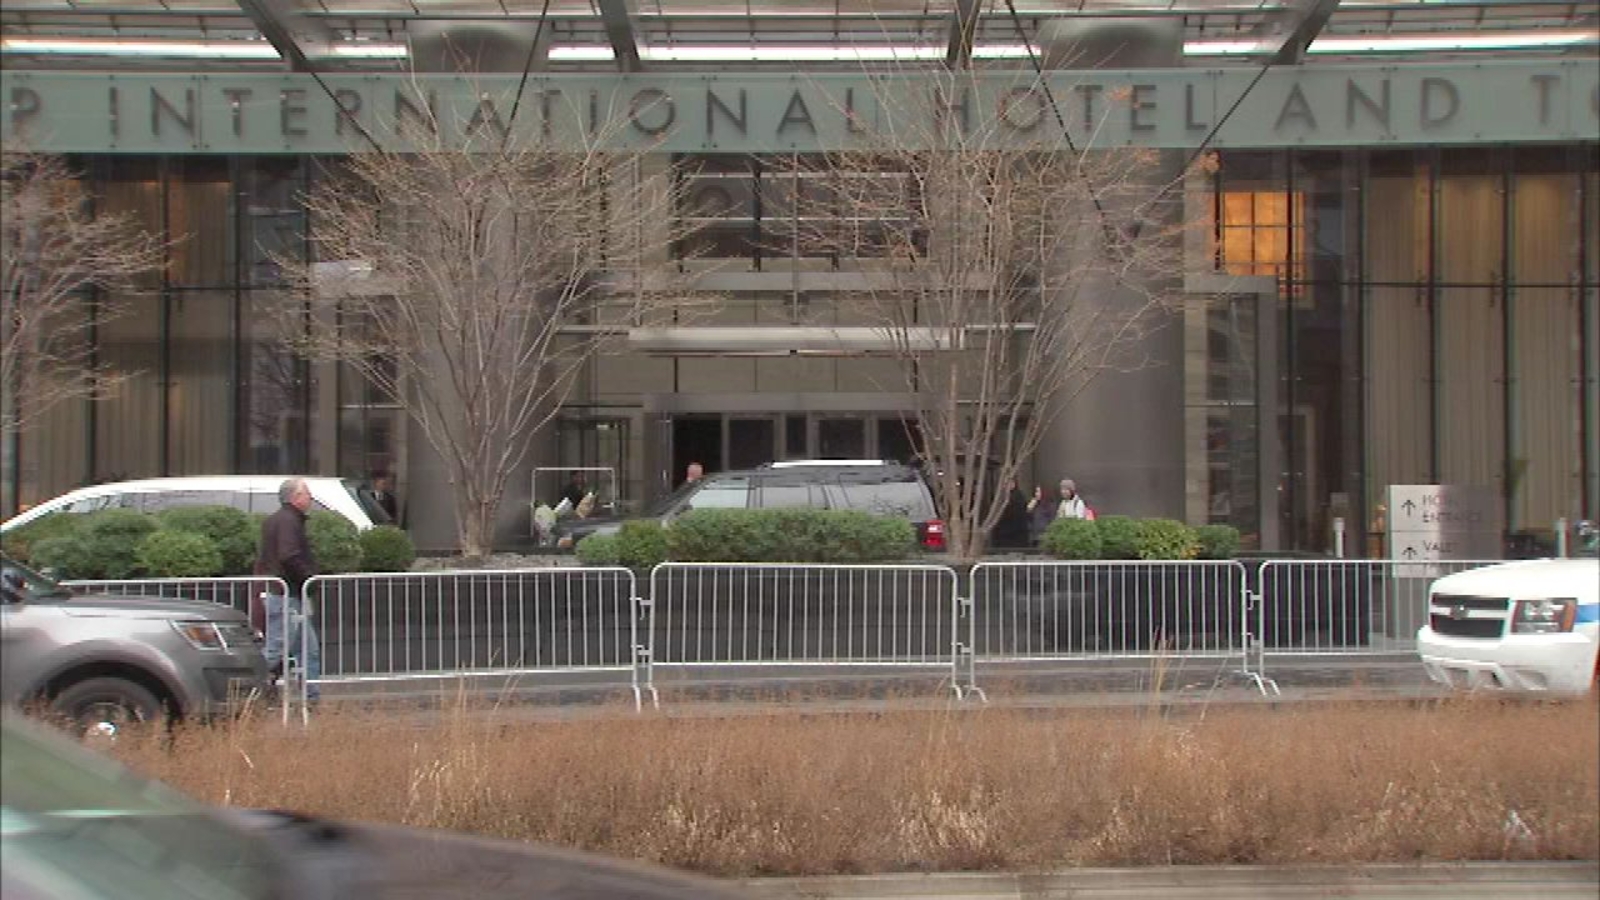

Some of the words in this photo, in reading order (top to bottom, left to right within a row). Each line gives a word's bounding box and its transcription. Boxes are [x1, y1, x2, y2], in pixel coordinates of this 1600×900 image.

[108, 85, 866, 138] INTERNATIONAL
[935, 84, 1208, 135] HOTEL
[1273, 78, 1460, 131] AND
[1530, 74, 1598, 126] T
